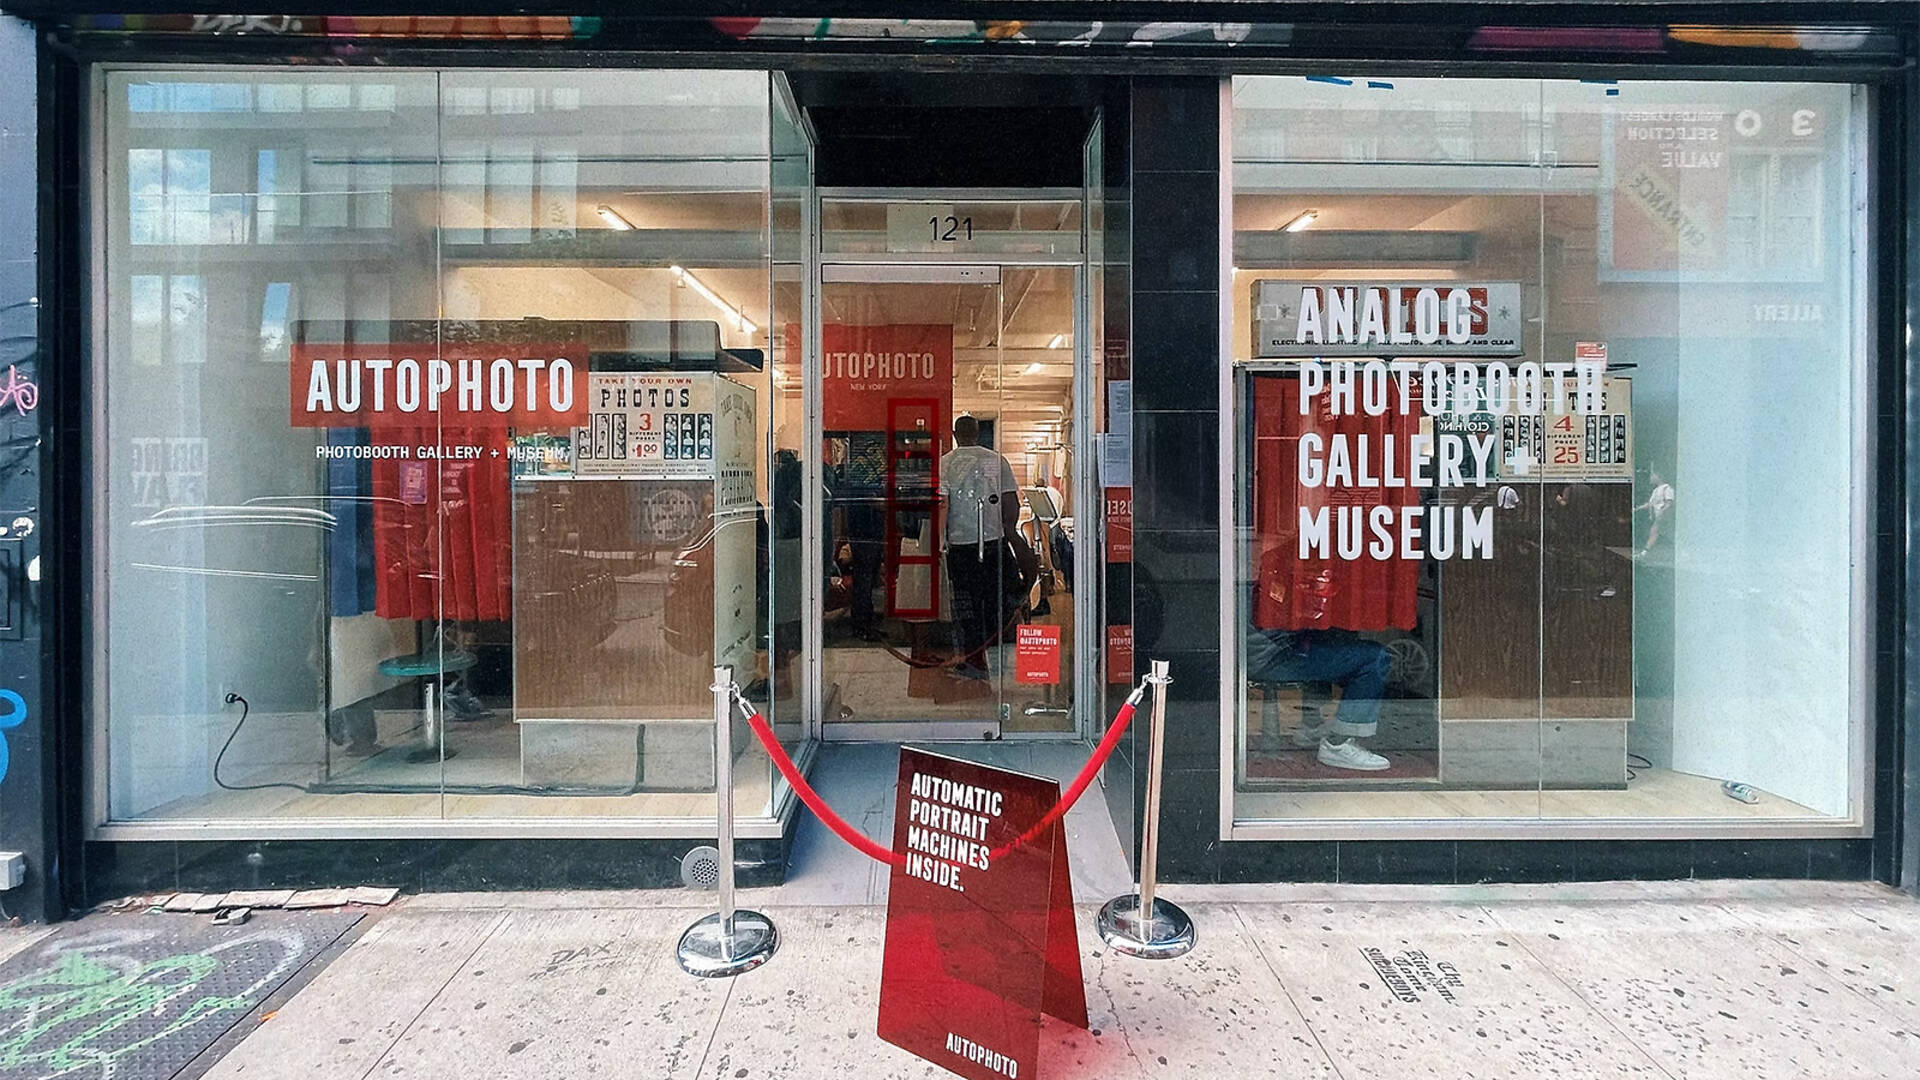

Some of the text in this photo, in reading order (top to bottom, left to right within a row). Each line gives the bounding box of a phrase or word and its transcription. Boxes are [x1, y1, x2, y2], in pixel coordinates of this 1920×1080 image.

[928, 216, 972, 242] 121
[1295, 287, 1472, 345] ANALOG
[306, 358, 575, 414] AUTOPHOTO
[601, 388, 690, 408] PHOTOS
[1298, 361, 1603, 417] PHOTOBOOTH
[639, 413, 652, 431] 3
[1553, 415, 1574, 432] 4
[316, 445, 410, 460] PHOTOBOOTH
[416, 445, 483, 460] GALLERY
[1298, 433, 1496, 488] GALLERY
[1298, 505, 1494, 561] MUSEUM
[910, 772, 1003, 816] AUTOMATIC
[909, 799, 990, 841] PORTRAIT
[907, 825, 990, 871] MACHINES
[905, 852, 964, 892] INSIDE.
[946, 1031, 1019, 1080] AUTOPHOTO
